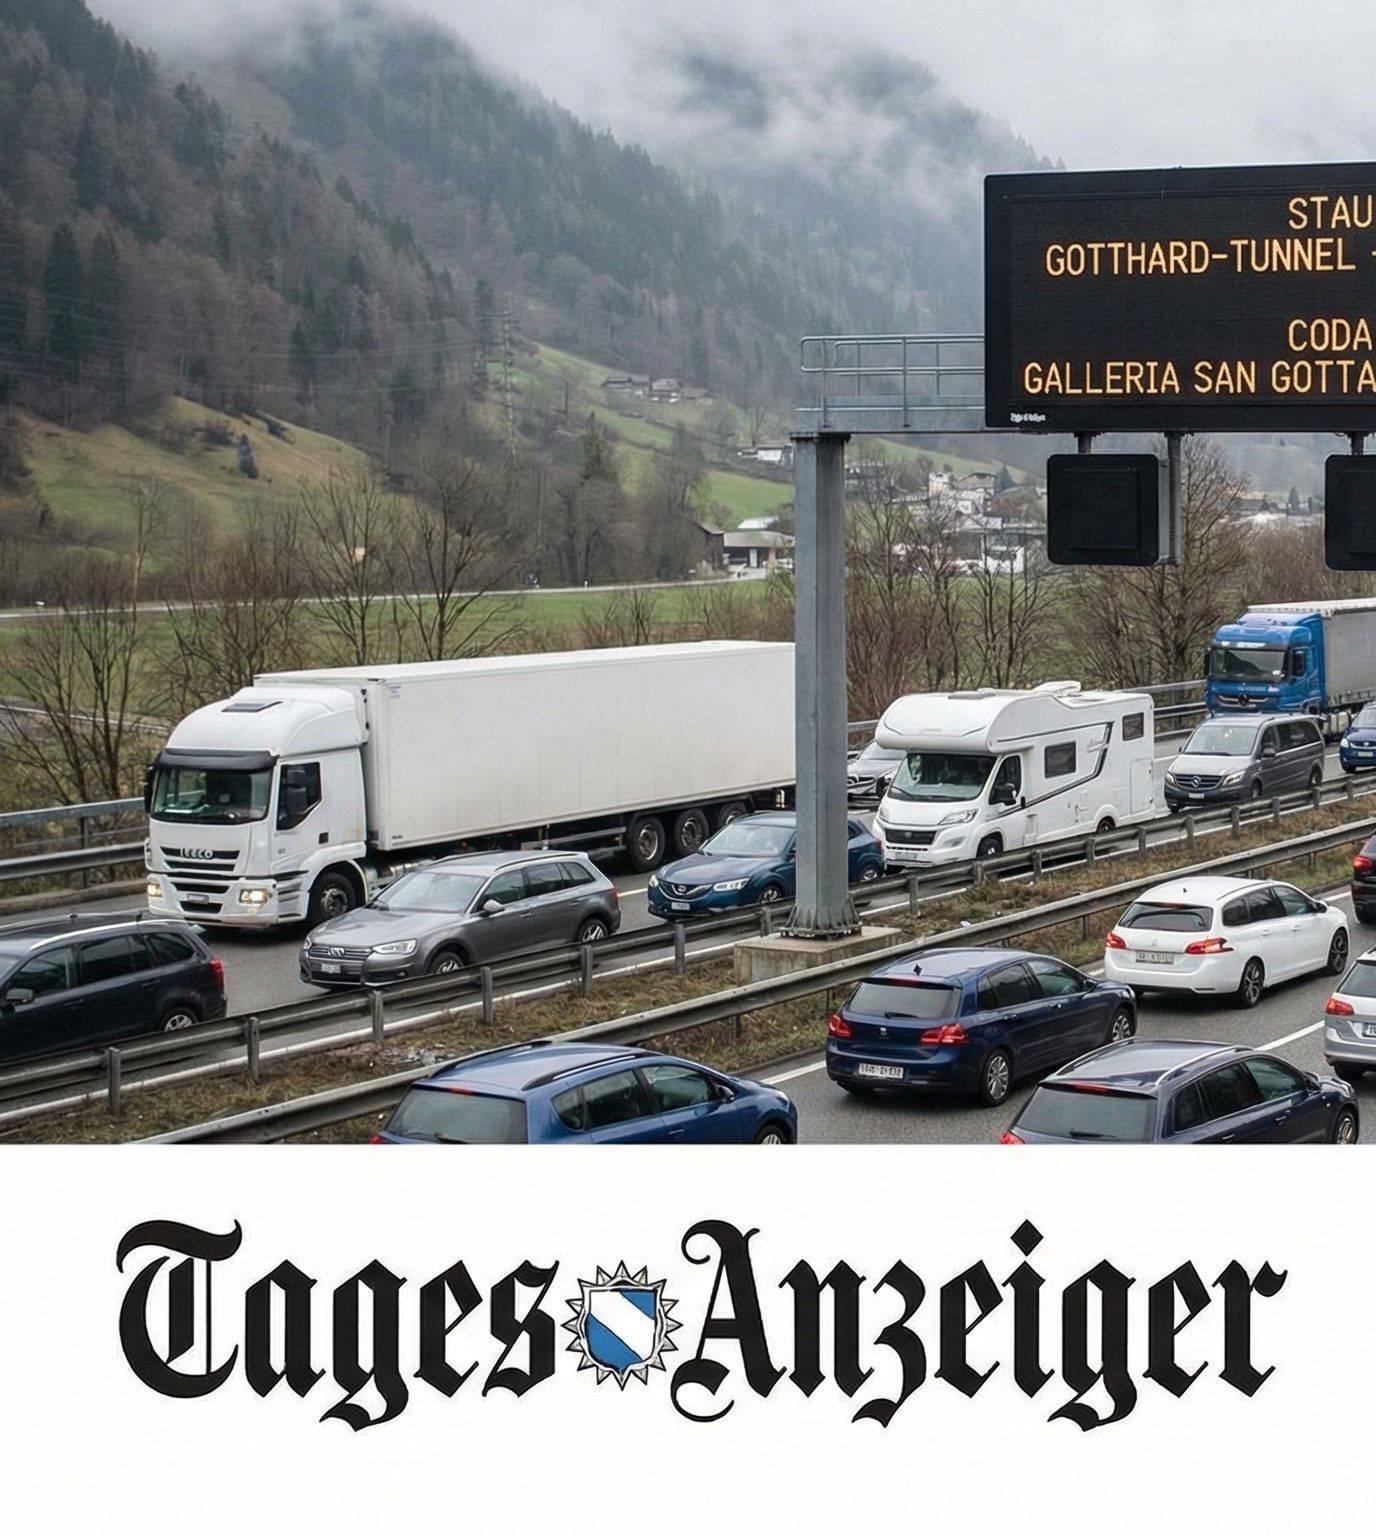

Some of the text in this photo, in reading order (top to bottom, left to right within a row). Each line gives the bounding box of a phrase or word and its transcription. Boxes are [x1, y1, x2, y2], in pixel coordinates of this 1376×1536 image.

[1288, 195, 1374, 230] STAU
[1046, 236, 1354, 277] GOTTHARD-TUNNEL
[1288, 317, 1374, 352] CODA
[1023, 360, 1181, 395] GALLERIA
[1193, 360, 1257, 394] SAN
